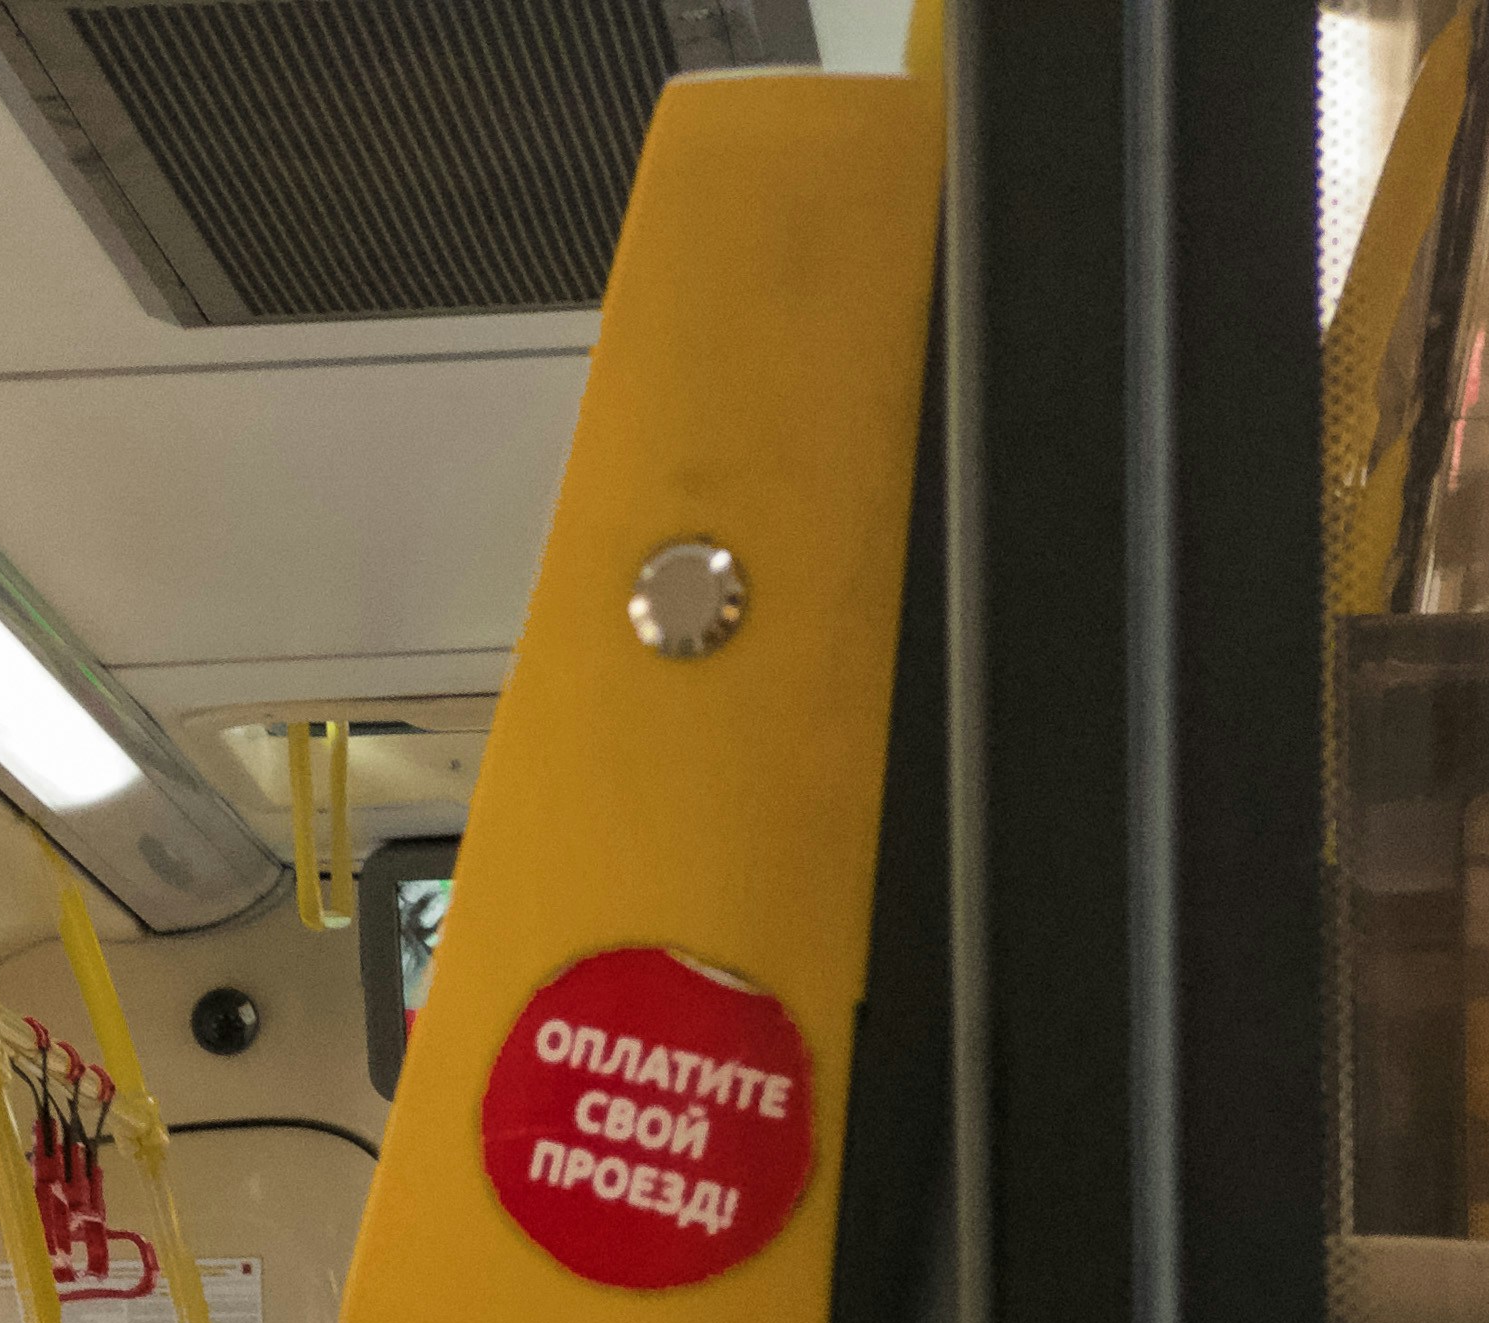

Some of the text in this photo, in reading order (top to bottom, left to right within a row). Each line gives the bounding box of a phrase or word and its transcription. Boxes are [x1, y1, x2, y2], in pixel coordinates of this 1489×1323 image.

[534, 1017, 795, 1120] ОПЛАТИТЕ
[573, 1089, 712, 1160] СВОЙ
[528, 1139, 742, 1236] ПРОЕЗД!
